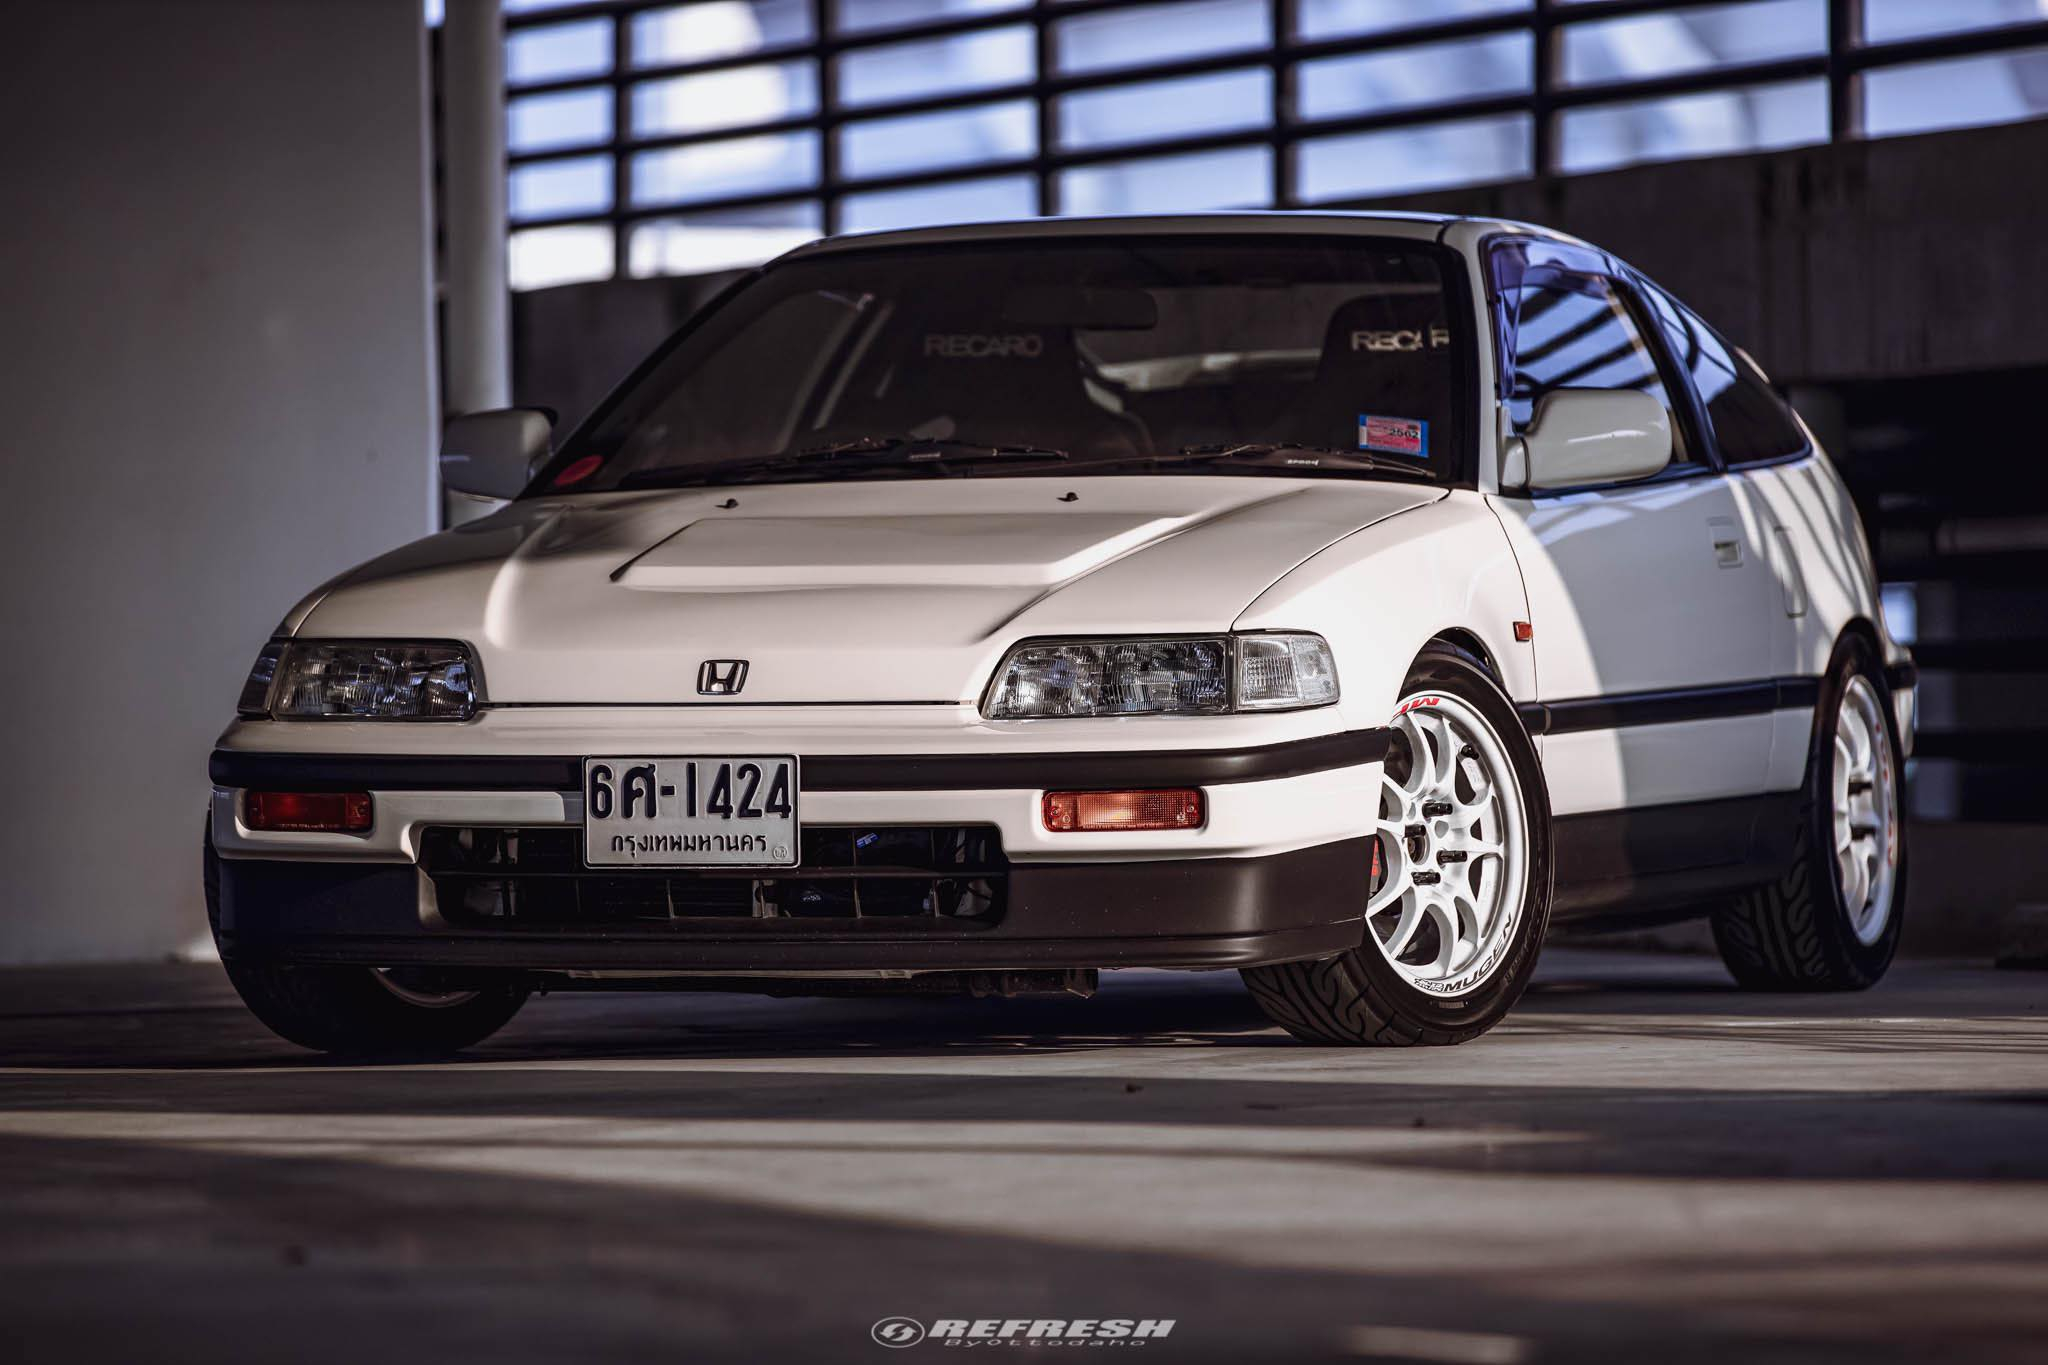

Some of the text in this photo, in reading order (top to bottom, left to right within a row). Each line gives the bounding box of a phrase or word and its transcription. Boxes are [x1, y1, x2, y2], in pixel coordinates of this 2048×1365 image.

[924, 334, 1043, 356] RECARO
[611, 834, 767, 858] กรุงเทพมหานคร
[1444, 911, 1512, 992] MUGEN
